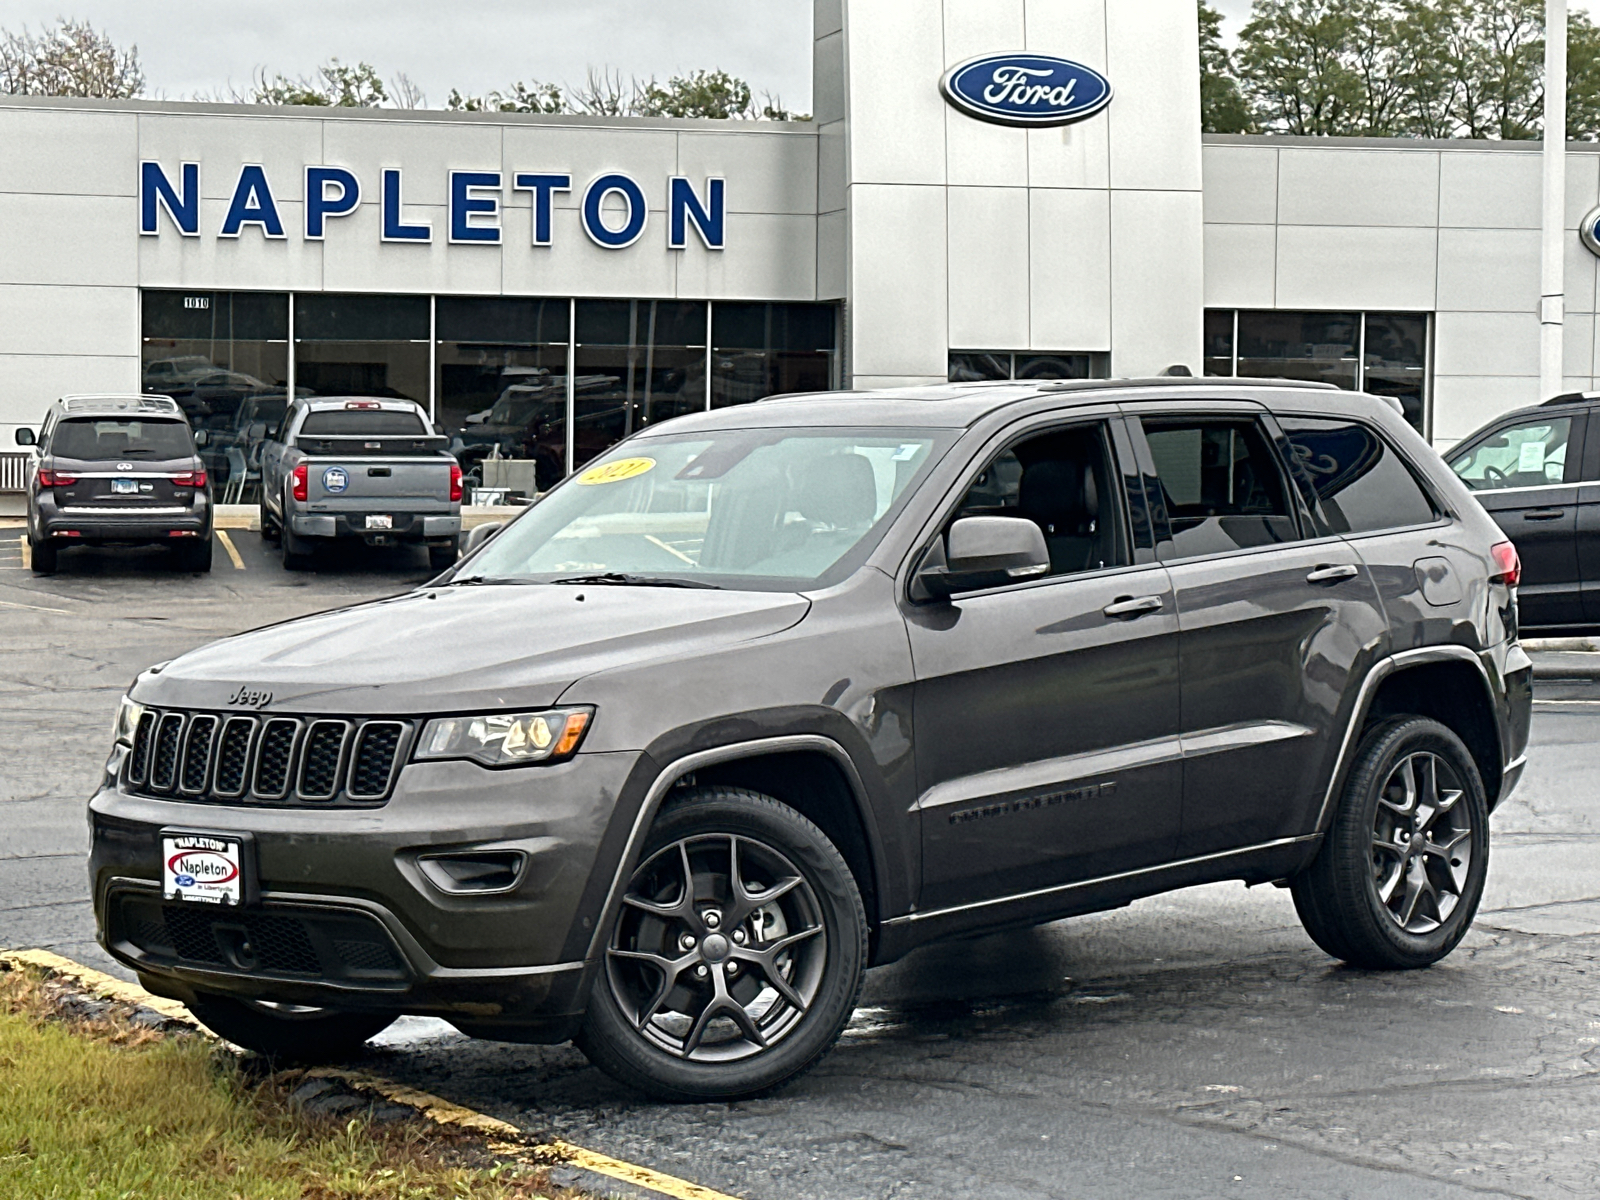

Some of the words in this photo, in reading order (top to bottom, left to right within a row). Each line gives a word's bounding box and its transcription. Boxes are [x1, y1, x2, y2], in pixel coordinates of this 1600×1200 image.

[983, 66, 1077, 106] Ford
[139, 160, 727, 251] NAPLETON
[184, 296, 209, 309] 1010
[228, 685, 273, 710] Jeep
[180, 857, 227, 877] Napleton
